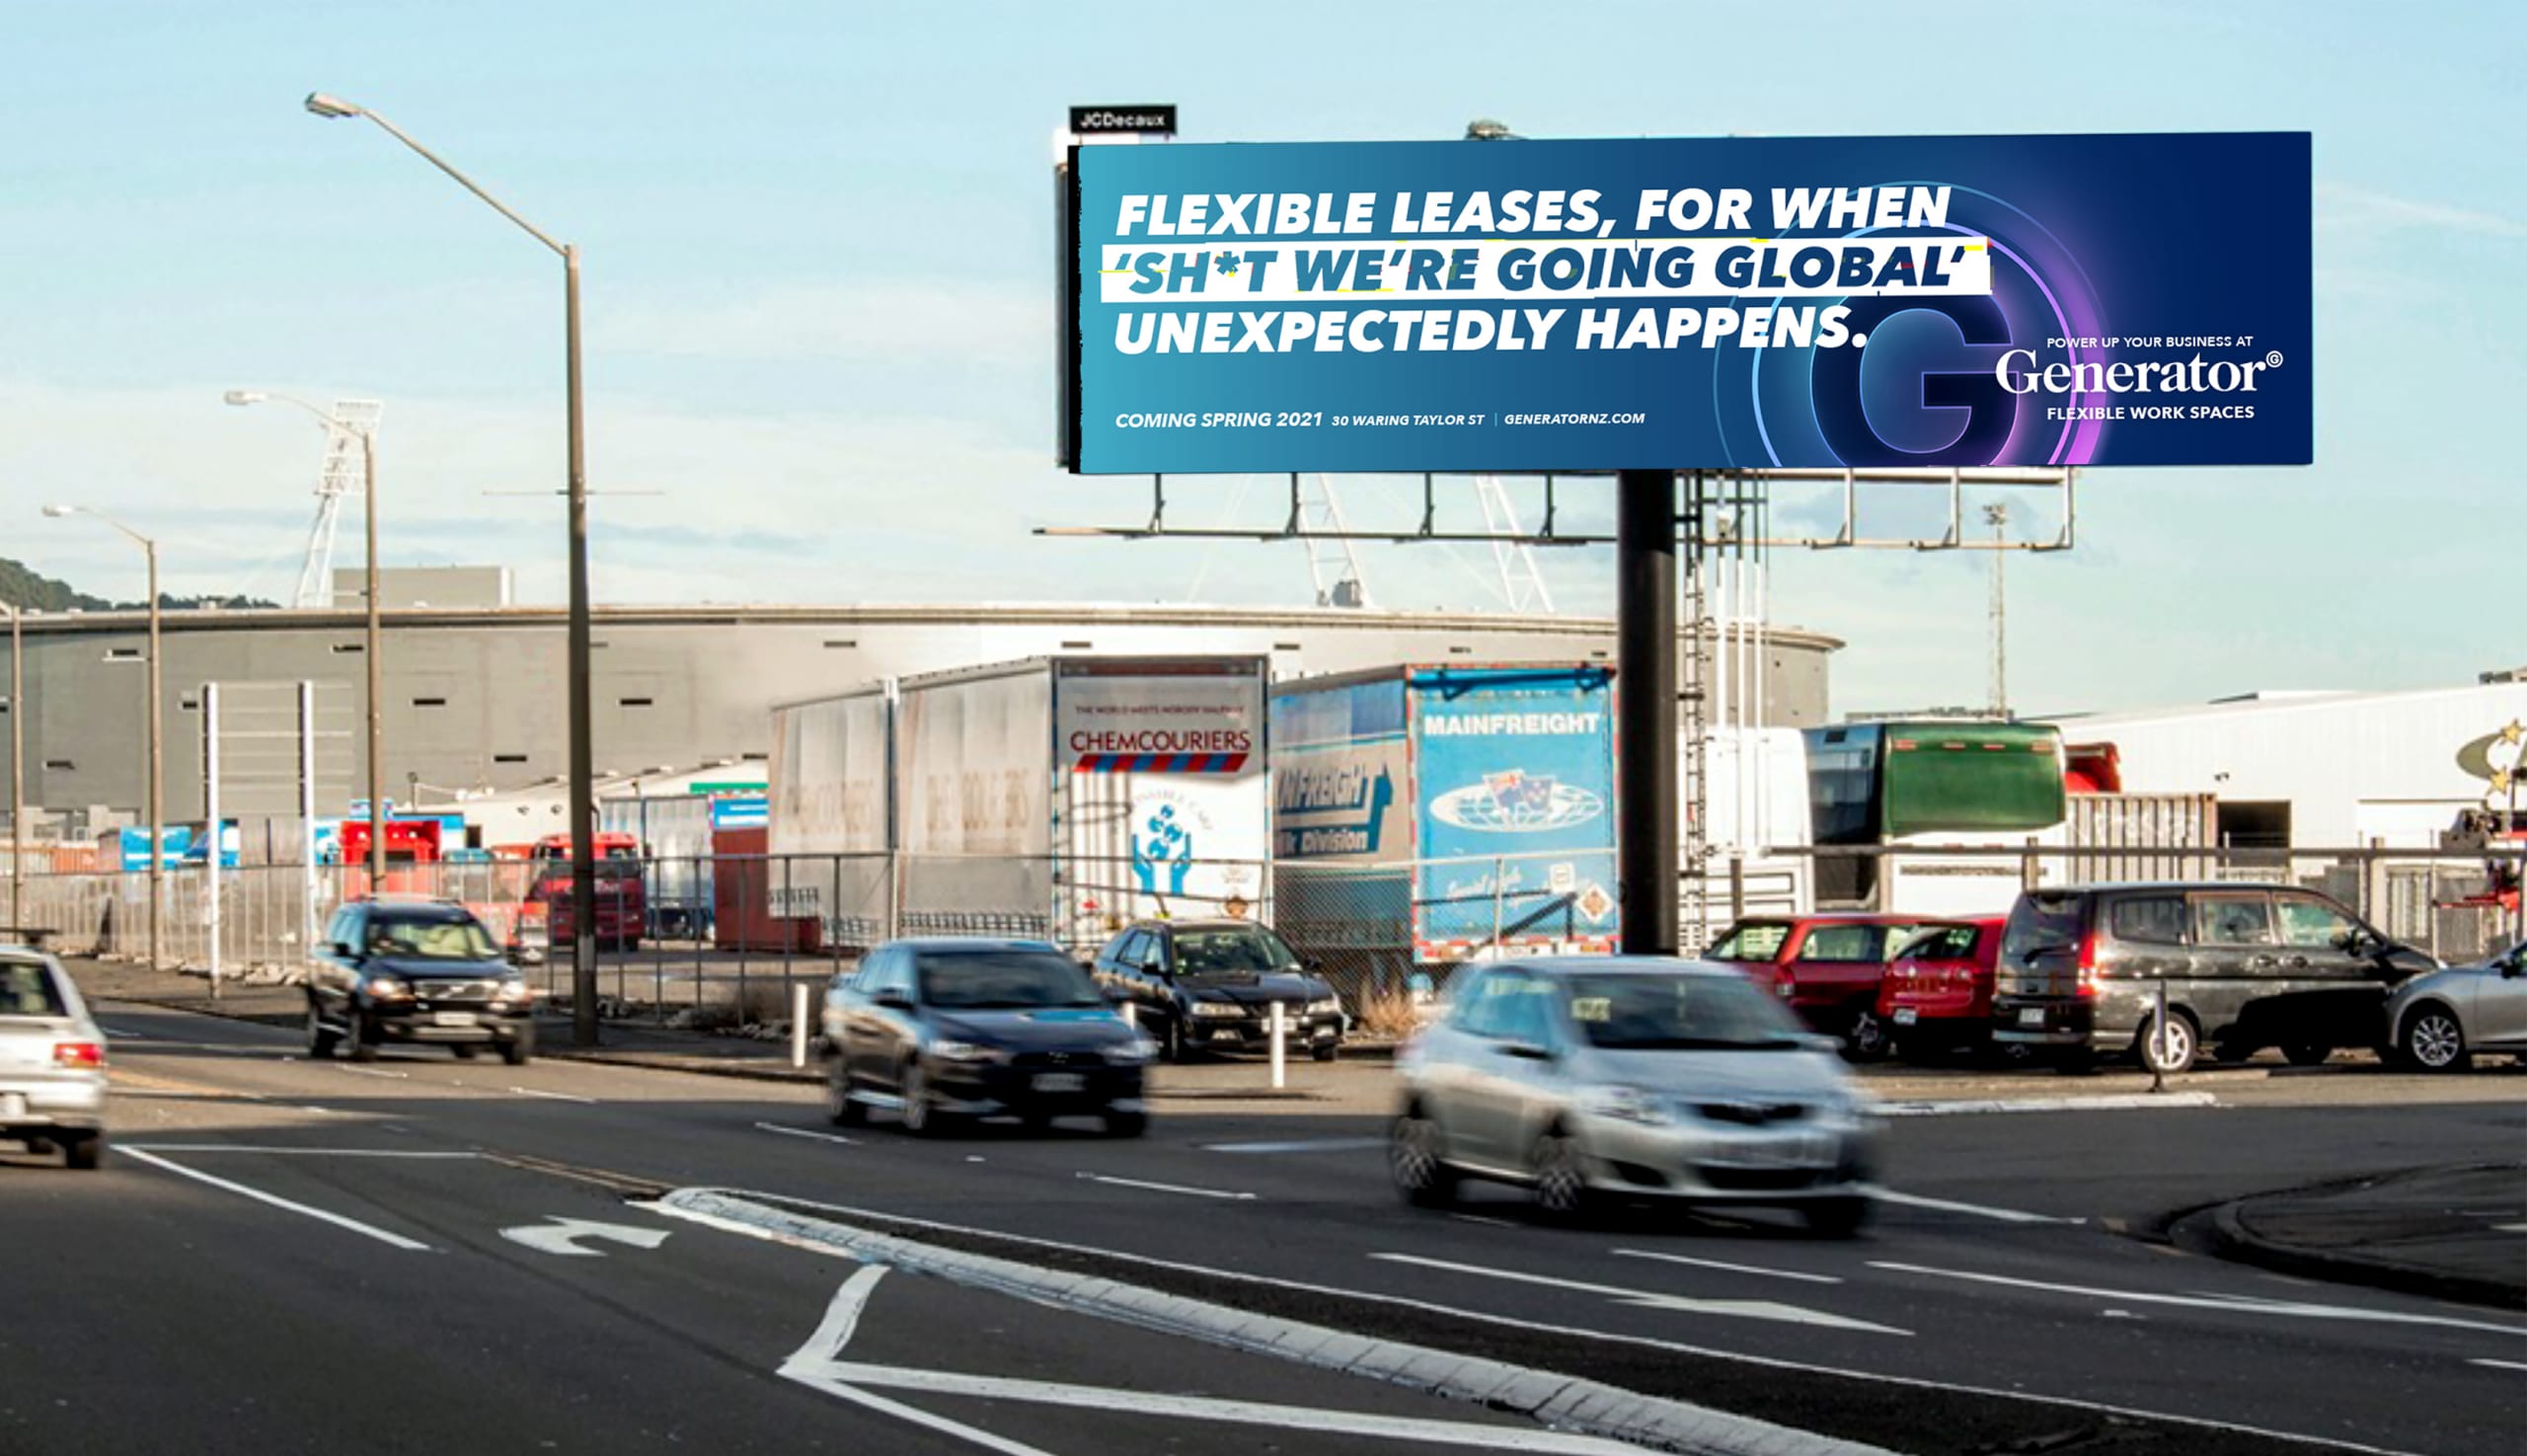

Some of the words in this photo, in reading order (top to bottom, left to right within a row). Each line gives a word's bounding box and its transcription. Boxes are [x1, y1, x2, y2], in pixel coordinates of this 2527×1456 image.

[1081, 113, 1165, 128] JCDecaux
[1115, 192, 1376, 236] FLEXIBLE
[1391, 190, 1616, 238] LEASES,
[1635, 188, 1752, 231] FOR
[1771, 186, 1952, 229] WHEN
[1295, 248, 1481, 291] WE'RE
[1497, 247, 1695, 290] GOING
[1714, 246, 1965, 289] GLOBAL'
[1115, 308, 1566, 354] UNEXPECTEDLY
[1576, 304, 1868, 349] HAPPENS.
[2047, 338, 2098, 348] POWER
[2102, 337, 2120, 347] UP
[2124, 337, 2162, 347] YOUR
[2167, 336, 2232, 347] BUSINESS
[2236, 336, 2254, 346] AT
[1995, 349, 2265, 394] Generator
[1115, 413, 1196, 428] COMING
[1201, 413, 1271, 427] SPRING
[1276, 412, 1322, 426] 2021
[1332, 416, 1349, 426] 30
[1352, 416, 1410, 426] WARING
[1414, 415, 1465, 425] TAYLOR
[1468, 415, 1486, 425] ST
[1504, 413, 1646, 424] GENERATORNZ.COM
[2047, 408, 2125, 421] FLEXIBLE
[2130, 407, 2185, 420] WORK
[2189, 406, 2255, 419] SPACES
[1423, 712, 1601, 736] MAINFREIGHT
[1070, 729, 1252, 752] CHEMCOURIERS
